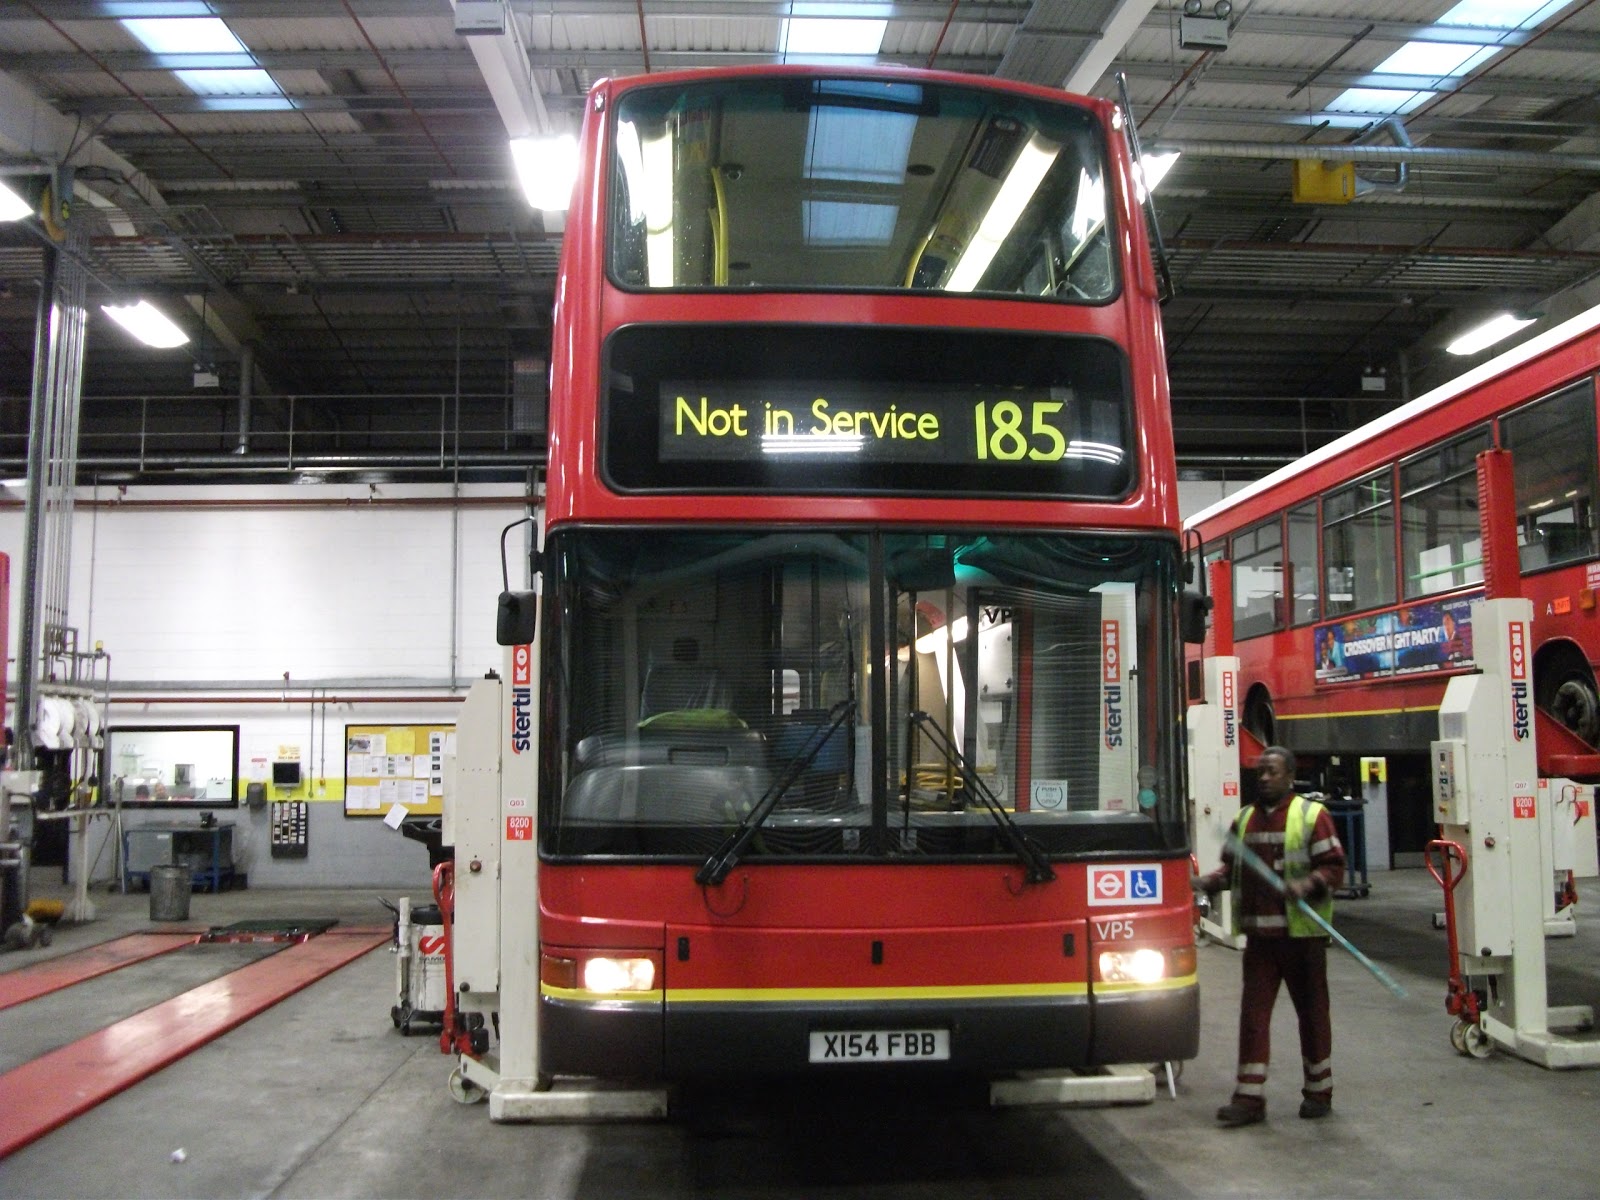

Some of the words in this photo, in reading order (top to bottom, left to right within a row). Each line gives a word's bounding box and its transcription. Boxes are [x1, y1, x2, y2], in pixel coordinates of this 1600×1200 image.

[676, 397, 748, 436] Not
[765, 402, 794, 436] in
[810, 398, 939, 440] Service
[975, 400, 1066, 461] 185
[1546, 602, 1553, 616] A
[1104, 622, 1119, 681] KONI
[1344, 635, 1387, 657] CROSSOVER
[1386, 631, 1411, 650] NGHT
[1411, 626, 1441, 646] PARTY
[1511, 623, 1524, 677] KONI
[515, 645, 529, 682] KO
[1224, 672, 1233, 707] KONI
[512, 688, 531, 754] stertil
[1104, 685, 1122, 751] stertil
[1224, 709, 1235, 748] stertil
[1510, 683, 1529, 742] stertil
[1515, 797, 1533, 808] 8200
[1520, 807, 1529, 818] kg
[510, 817, 530, 829] 8200
[515, 828, 525, 840] kg
[1096, 921, 1135, 940] VP5
[823, 1034, 879, 1058] X154
[887, 1033, 936, 1056] FBB
